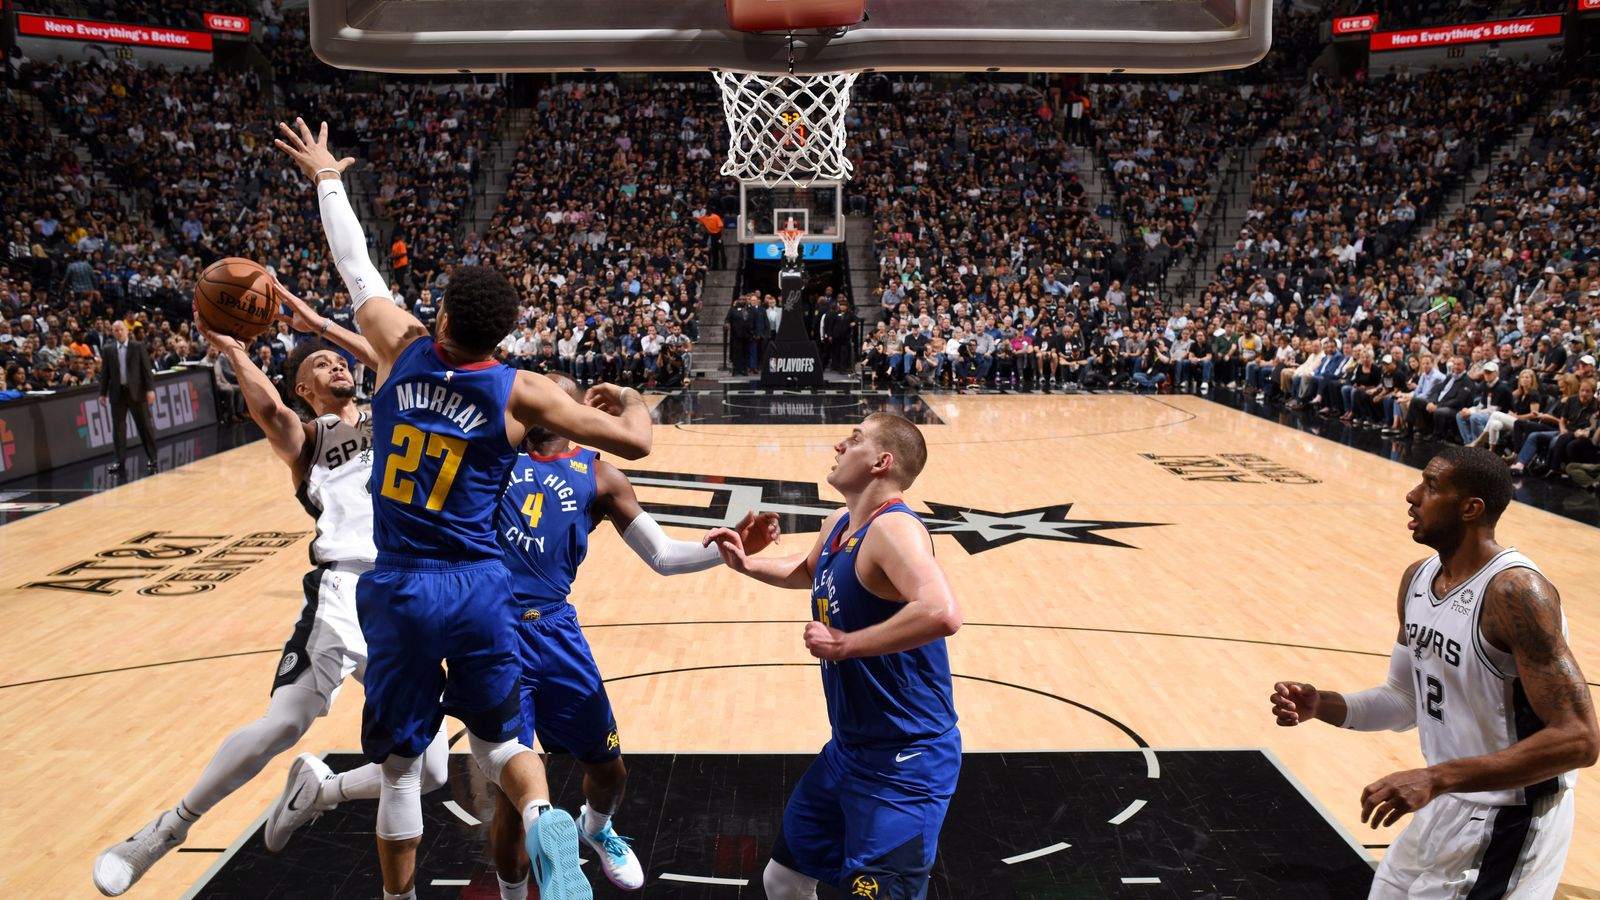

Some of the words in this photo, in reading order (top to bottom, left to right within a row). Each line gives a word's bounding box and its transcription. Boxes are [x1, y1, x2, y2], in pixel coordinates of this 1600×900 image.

[44, 20, 74, 33] Here
[77, 24, 149, 42] Everything's
[151, 31, 189, 45] Better.
[1392, 34, 1417, 45] Here
[1420, 27, 1490, 43] Everything's
[1493, 22, 1535, 36] Better.
[219, 291, 270, 320] SPALDIN
[776, 357, 815, 372] PLAYOFFS
[168, 382, 194, 426] GO
[396, 382, 488, 434] MURRAY
[381, 423, 469, 512] 27
[521, 493, 544, 528] 4
[543, 474, 577, 512] HIGH
[505, 526, 545, 553] CITY
[17, 531, 234, 597] AT&T
[137, 531, 312, 597] CENTER
